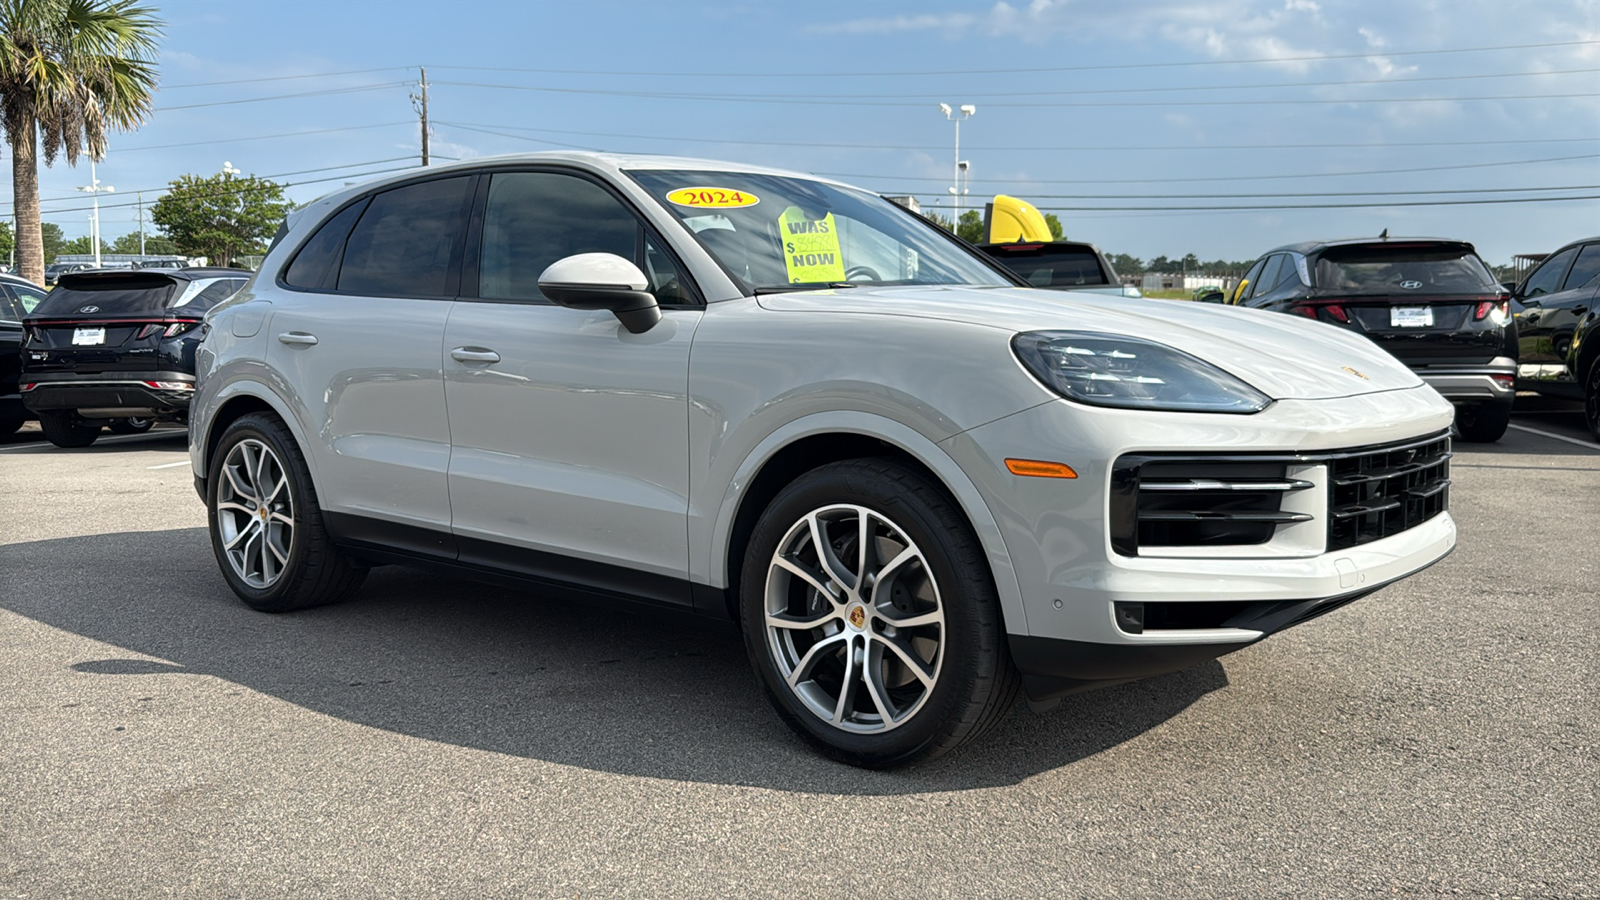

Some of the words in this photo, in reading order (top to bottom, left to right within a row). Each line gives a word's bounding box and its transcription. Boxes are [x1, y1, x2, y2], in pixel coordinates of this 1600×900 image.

[685, 191, 744, 205] 2024
[788, 221, 829, 235] WAS
[787, 242, 796, 254] $
[793, 253, 835, 267] NOW
